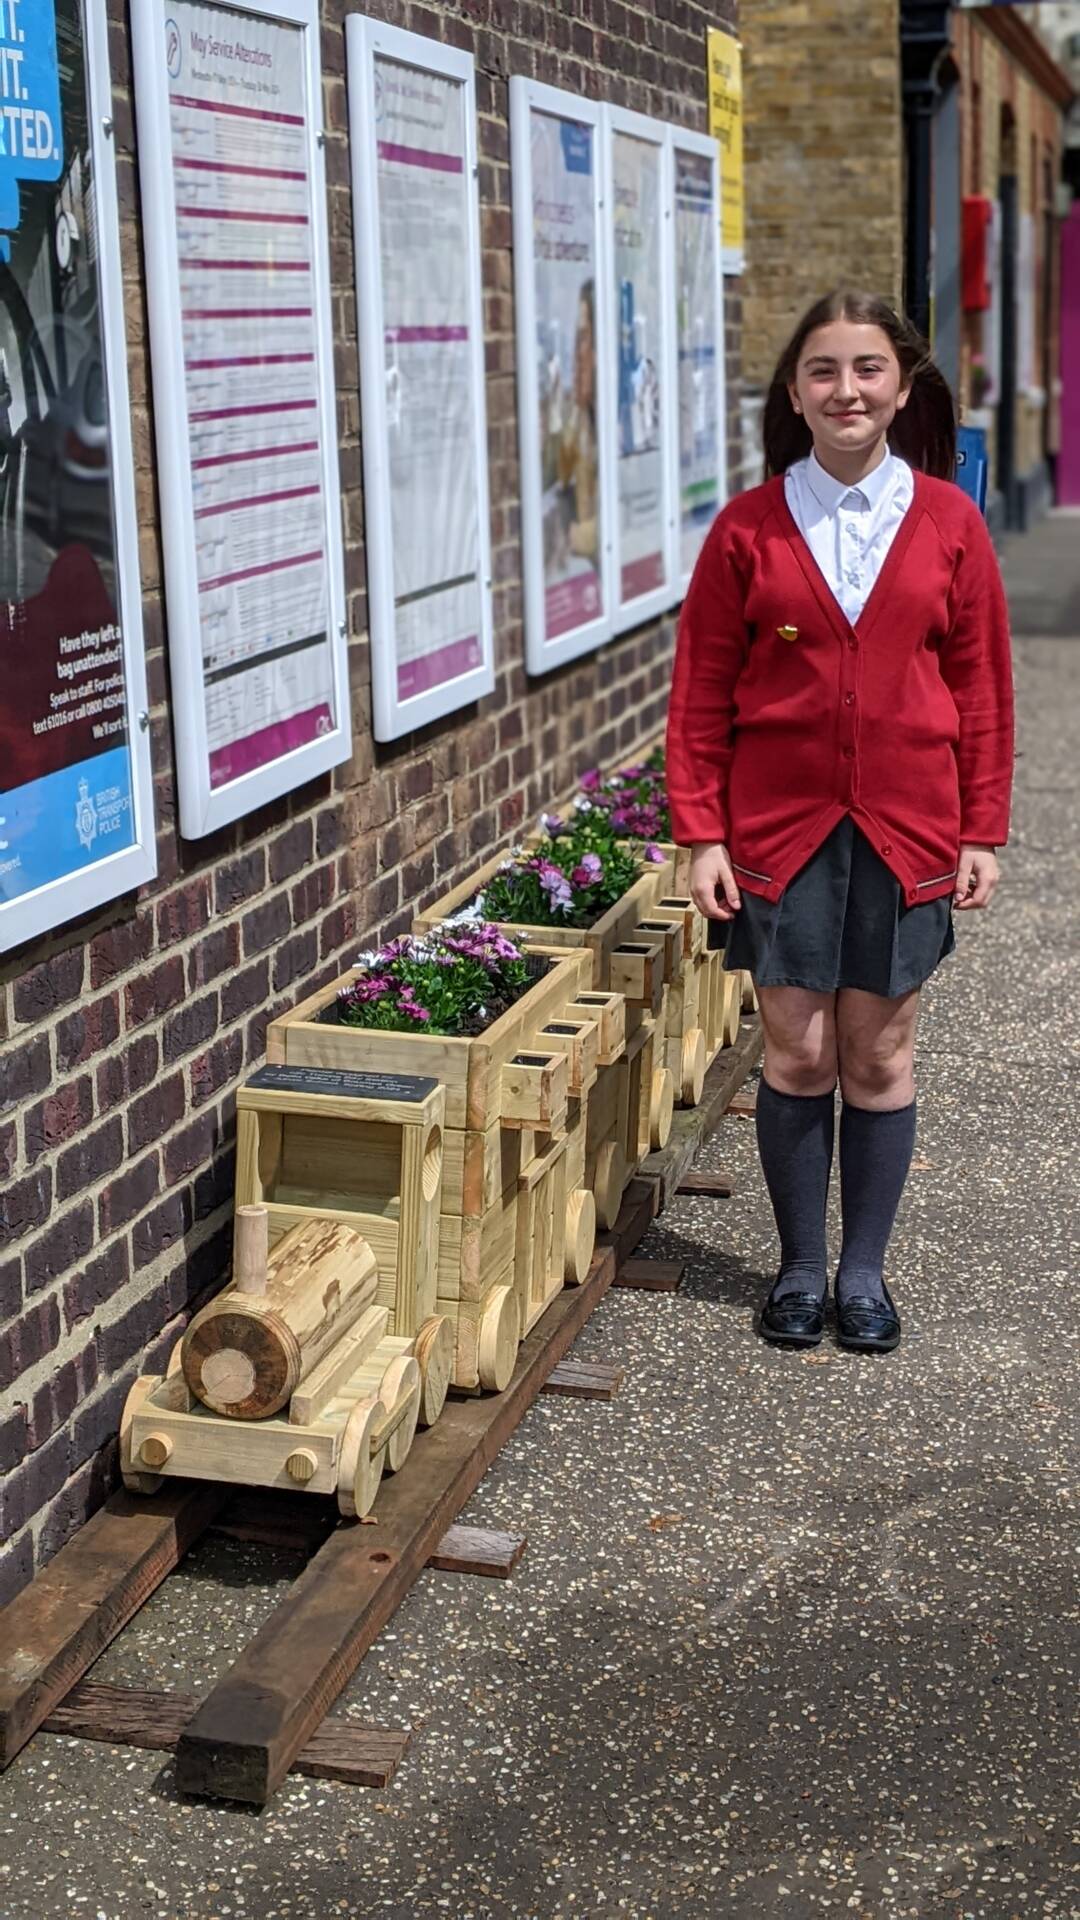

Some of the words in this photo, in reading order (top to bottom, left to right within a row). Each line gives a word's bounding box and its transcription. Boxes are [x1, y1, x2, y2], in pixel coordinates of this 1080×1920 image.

[59, 637, 81, 654] Have
[81, 630, 100, 650] they
[100, 624, 116, 643] left
[56, 661, 74, 680] bag
[49, 689, 70, 710] Speak
[69, 689, 78, 701] to
[94, 678, 105, 692] For
[33, 717, 48, 735] text
[47, 711, 68, 730] 61016
[67, 711, 76, 723] or
[75, 703, 87, 720] call
[109, 718, 122, 735] sort
[96, 786, 121, 807] BRITISH
[98, 814, 121, 836] POLICE
